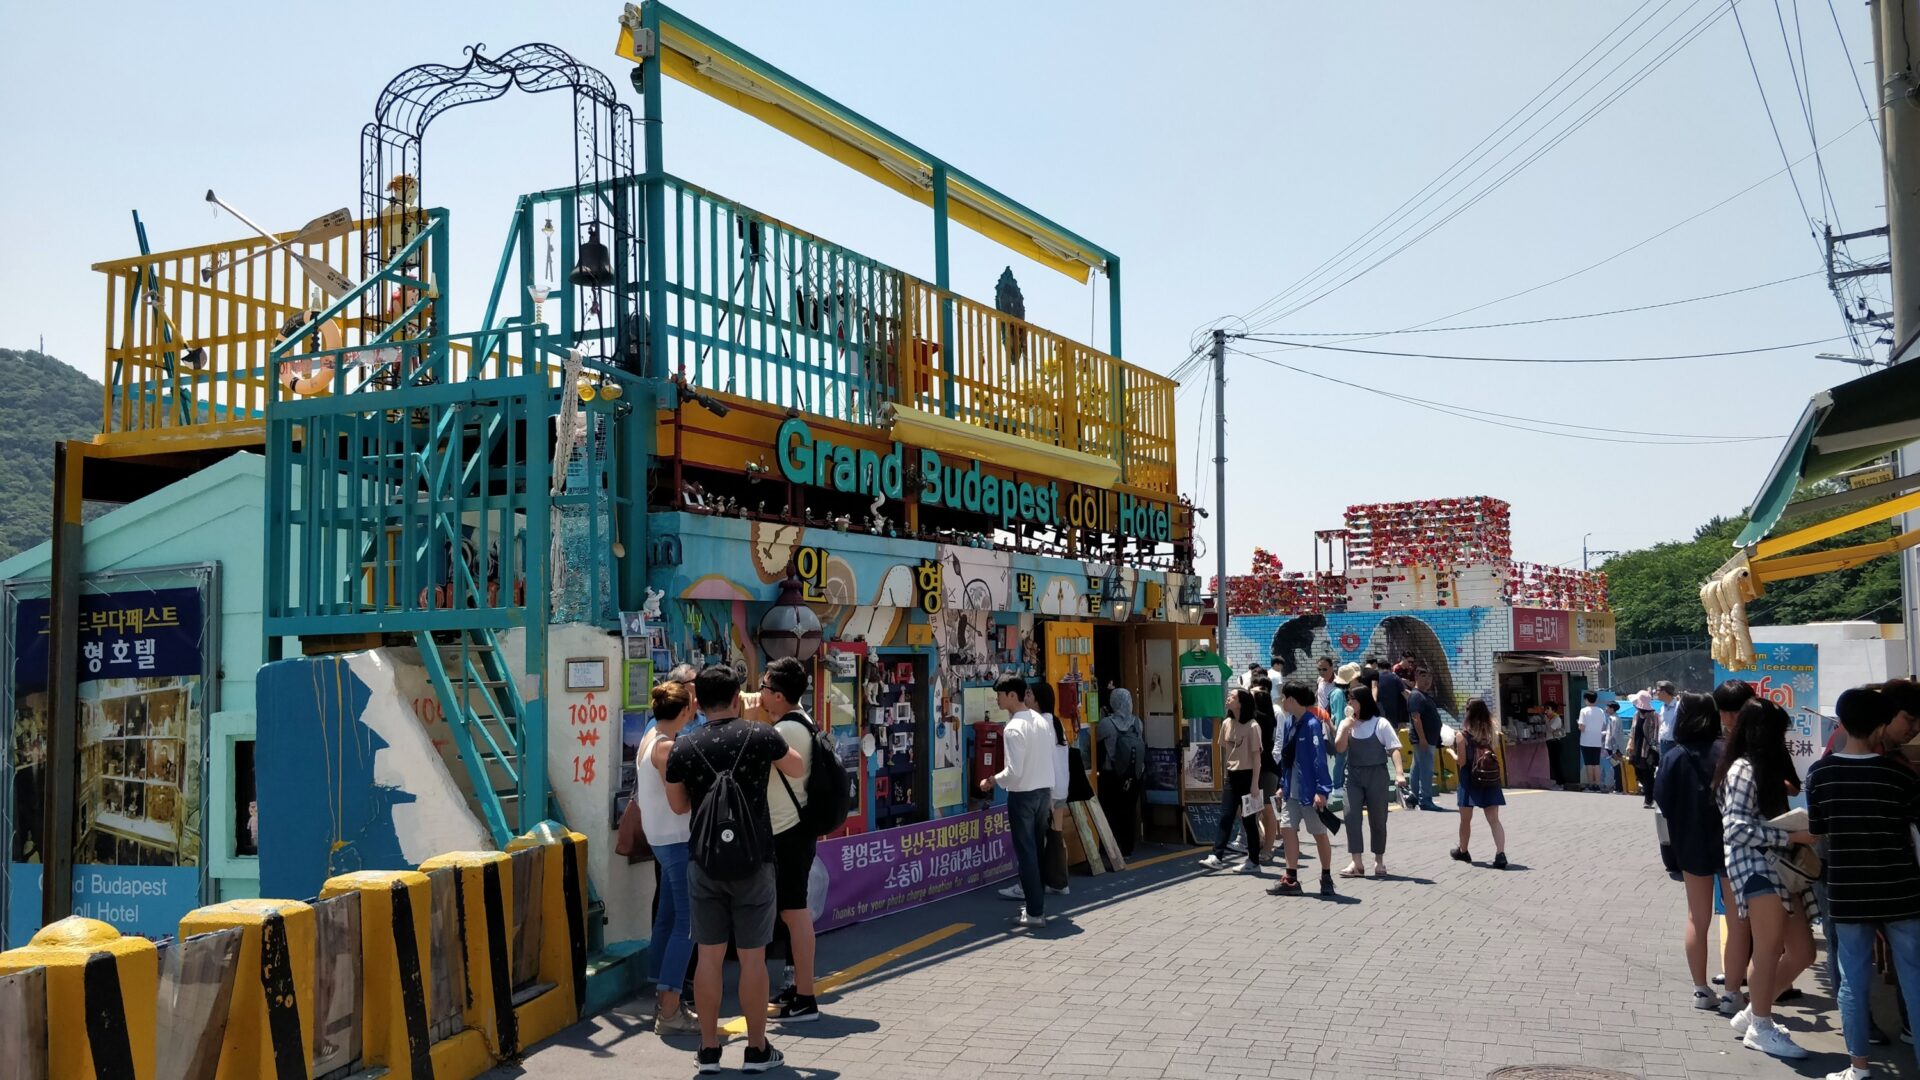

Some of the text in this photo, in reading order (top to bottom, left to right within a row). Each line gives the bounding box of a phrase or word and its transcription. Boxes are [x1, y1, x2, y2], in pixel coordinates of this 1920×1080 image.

[777, 418, 1172, 542] Grand Budapest doll Hotel
[1763, 663, 1815, 672] Icecream
[568, 703, 608, 725] 1000
[573, 754, 596, 785] 1$
[841, 838, 895, 872] 촬영료는
[91, 873, 168, 898] Budapest
[883, 859, 923, 889] 소중히
[74, 901, 139, 923] oll Hotel
[832, 905, 855, 920] Thanks
[857, 902, 869, 914] for
[870, 899, 886, 913] your
[886, 893, 905, 910] photo
[906, 888, 927, 902] charge
